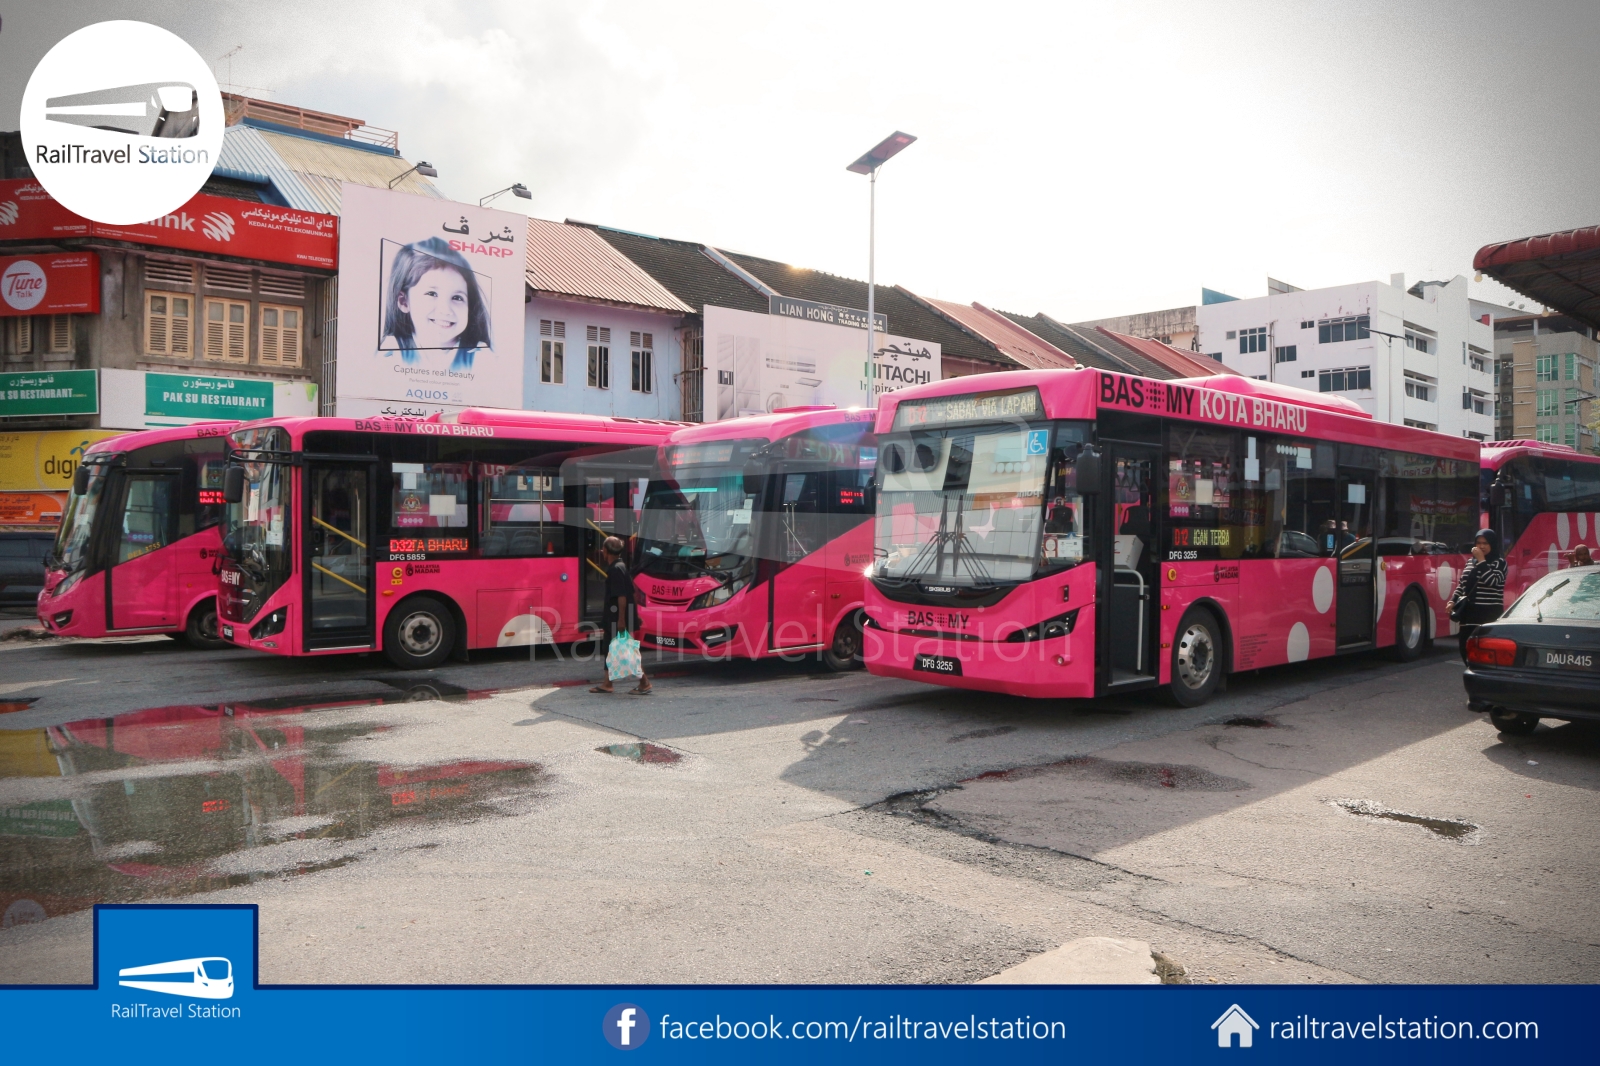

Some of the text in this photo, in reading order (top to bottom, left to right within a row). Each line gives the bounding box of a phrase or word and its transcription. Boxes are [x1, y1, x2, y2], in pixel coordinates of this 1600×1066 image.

[284, 226, 333, 238] TELEKOMUNIKASI
[448, 239, 514, 258] SHARP
[6, 272, 42, 296] Tune
[780, 302, 802, 316] LIAN
[806, 307, 834, 322] HONG
[838, 318, 859, 327] TRADING
[394, 364, 430, 376] Captures
[448, 370, 475, 381] beauty
[8, 390, 18, 400] SU
[20, 388, 73, 399] RESTAURANT
[163, 392, 265, 407] PAK SU RESTAURANT
[406, 389, 448, 400] AQUOS
[1101, 373, 1307, 432] BAS MY KOTA BHARU
[946, 400, 977, 420] SABAK
[844, 413, 860, 422] BAS
[197, 428, 218, 437] BAS
[354, 420, 494, 436] BAS MY KOTA BHARU
[428, 539, 468, 551] BHARU
[1169, 550, 1197, 560] DFG 3255
[652, 585, 684, 596] BAS MY
[908, 611, 969, 629] BAS MY
[922, 658, 953, 671] DFG 3255
